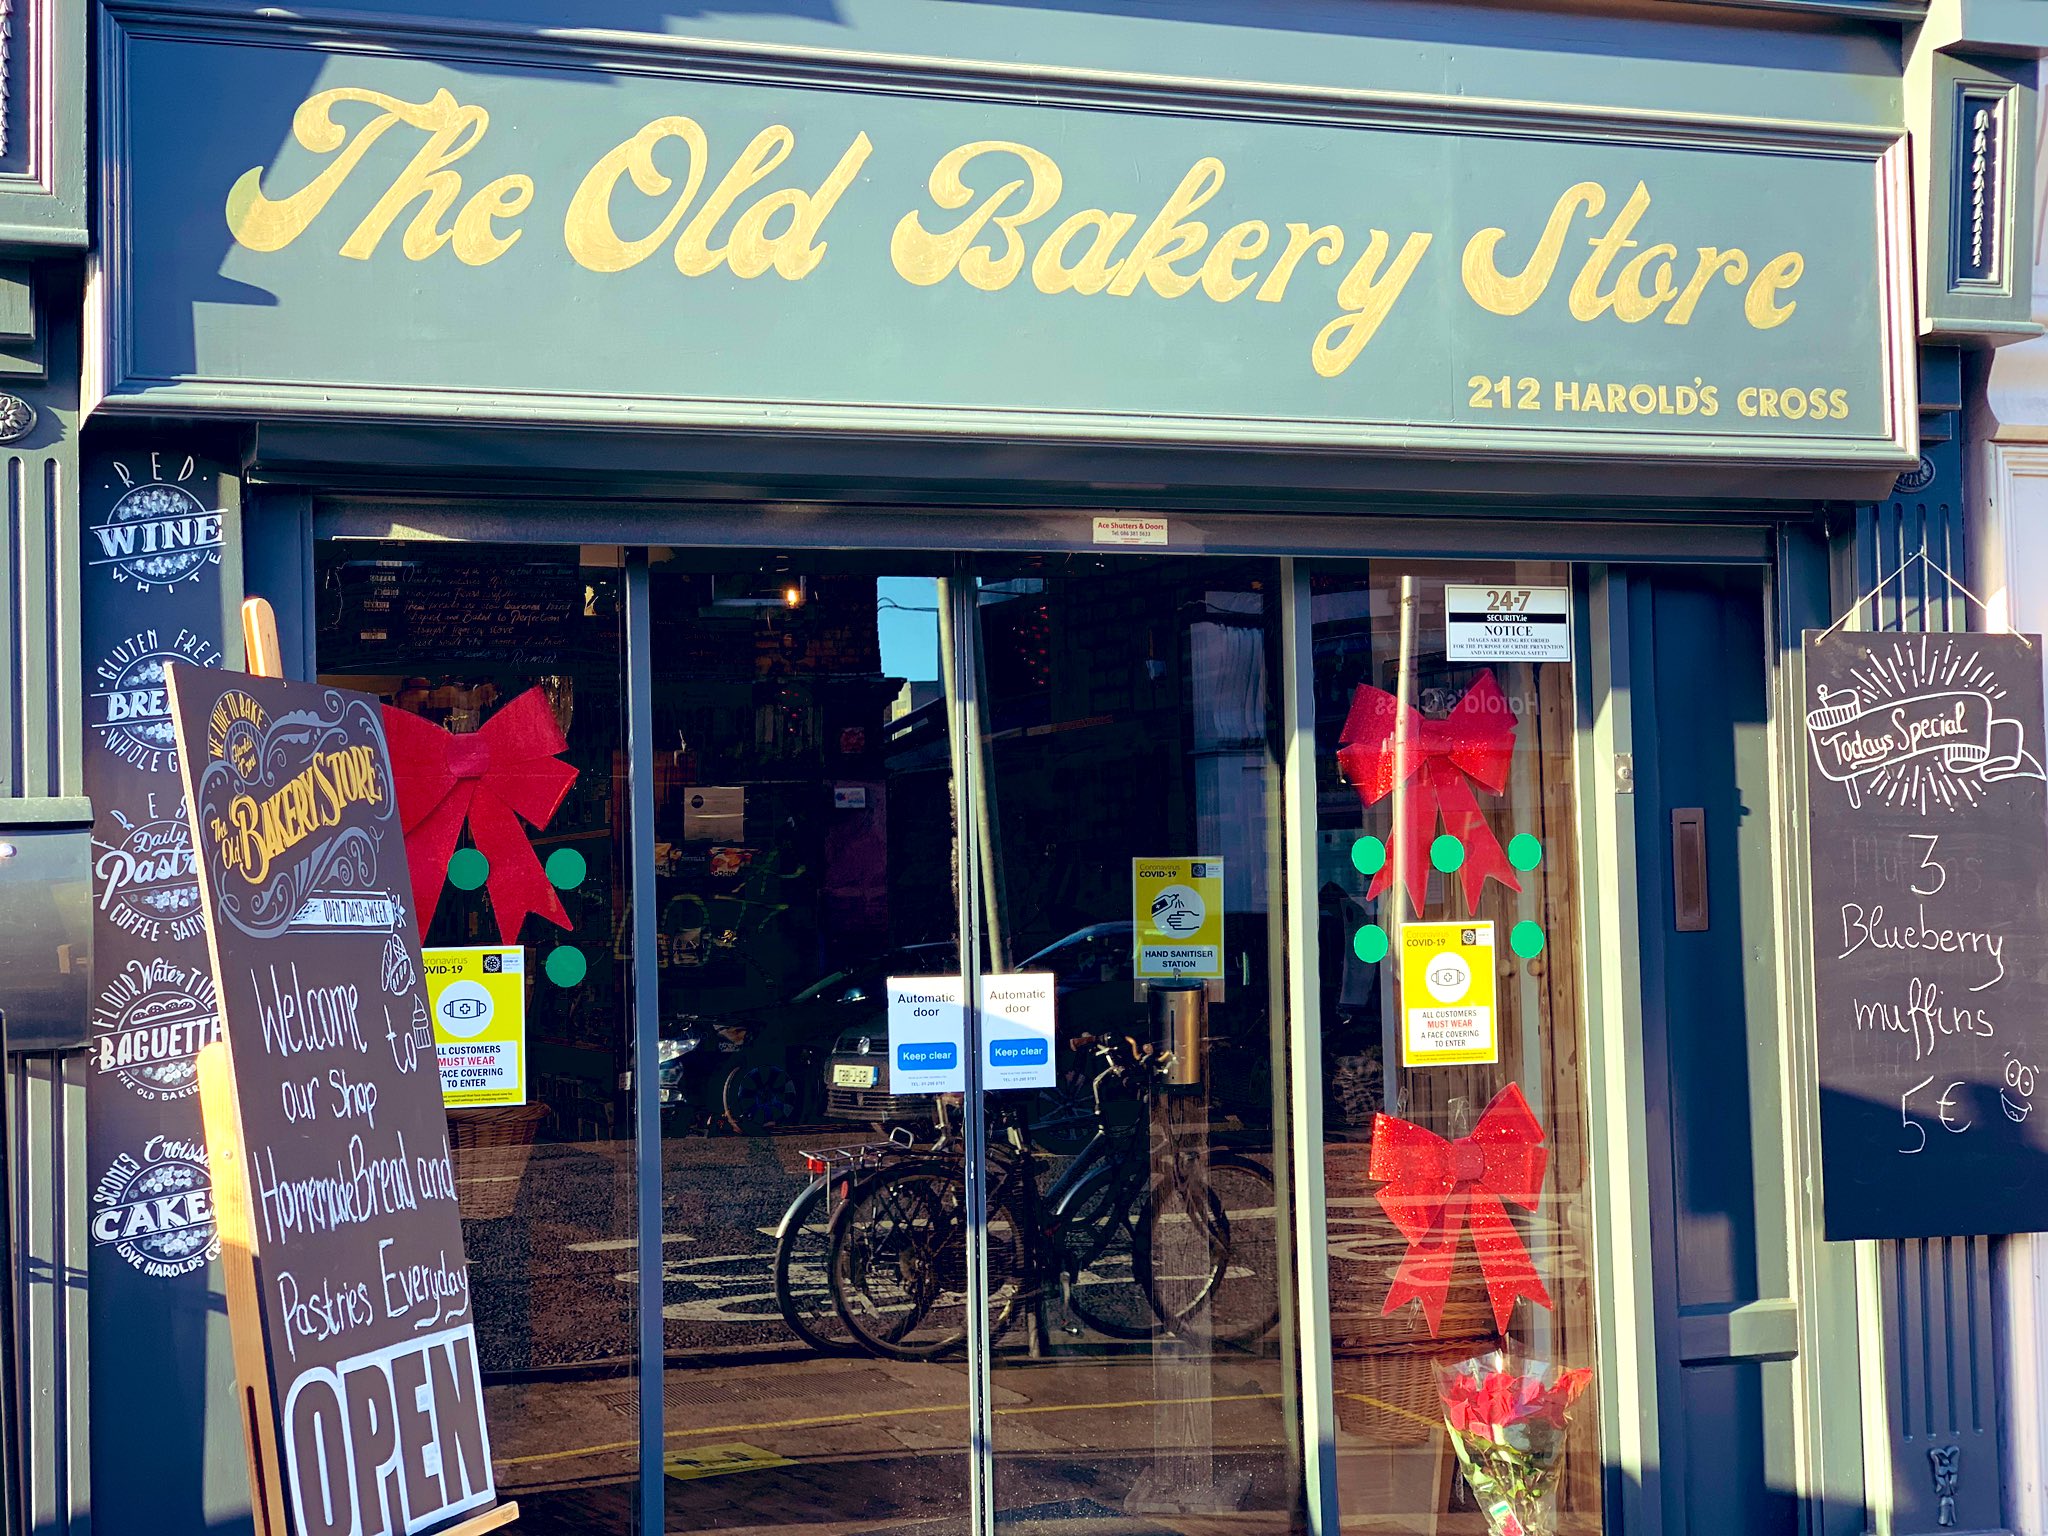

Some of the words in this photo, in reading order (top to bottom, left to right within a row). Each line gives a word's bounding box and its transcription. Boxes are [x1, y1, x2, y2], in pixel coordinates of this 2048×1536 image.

[226, 87, 534, 266] The
[565, 115, 873, 280] Old
[890, 140, 1433, 378] Bakery
[1461, 179, 1804, 330] Store
[1467, 374, 1541, 411] 212
[1554, 376, 1720, 417] HAROLD'S
[1737, 386, 1850, 421] CROSS
[113, 451, 195, 489] RED
[93, 513, 223, 558] WINE
[112, 550, 222, 594] WHITE
[1484, 625, 1533, 637] NOTICE
[97, 629, 159, 681] GLUTEN
[173, 628, 222, 669] FREE
[106, 690, 173, 722] BRE
[210, 701, 231, 740] LOVE
[224, 692, 240, 720] TO
[238, 692, 265, 731] BAKE
[104, 727, 161, 773] WHOLE
[209, 733, 224, 759] WE
[1820, 729, 1895, 770] Todays
[1890, 700, 1968, 754] Special
[210, 816, 229, 843] The
[229, 766, 326, 885] BAKERY
[312, 745, 383, 828] STORE
[132, 823, 190, 854] Daily
[221, 833, 243, 870] Old
[1139, 863, 1181, 871] Coronavirus
[1139, 870, 1177, 878] COVID-19
[1907, 834, 1947, 896] 3
[109, 902, 161, 942] COFFEE
[323, 900, 342, 923] OPEN
[341, 900, 348, 923] 7
[347, 901, 365, 923] DAYS
[367, 900, 390, 924] WEEK
[1406, 930, 1449, 938] Coronavirus
[1406, 938, 1446, 947] COVID-19
[1837, 902, 2005, 991] Blueberry
[1144, 950, 1169, 958] HAND
[1170, 950, 1213, 958] SANITISER
[1162, 960, 1196, 968] STATION
[92, 973, 142, 1029] FLOUR
[126, 957, 186, 994] Water
[897, 993, 956, 1004] Automatic
[989, 990, 1046, 1000] Automatic
[250, 961, 368, 1057] Welcome
[383, 1004, 418, 1075] to
[913, 1007, 940, 1017] door
[1005, 1004, 1031, 1013] door
[1435, 1009, 1477, 1018] CUSTOMERS
[1853, 976, 1995, 1062] muffins
[1427, 1020, 1449, 1029] MUST
[1450, 1019, 1473, 1028] WEAR
[1427, 1031, 1444, 1039] FACE
[1445, 1030, 1480, 1038] COVERING
[437, 1047, 447, 1055] LL
[448, 1045, 501, 1055] CUSTOMERS
[903, 1051, 927, 1062] Keep
[928, 1050, 952, 1060] clear
[994, 1048, 1019, 1058] Keep
[1020, 1046, 1043, 1056] clear
[1435, 1040, 1444, 1048] TO
[1445, 1039, 1466, 1047] ENTER
[438, 1057, 465, 1066] MUST
[467, 1056, 495, 1065] WEAR
[460, 1067, 503, 1077] COVERING
[116, 1070, 136, 1090] THE
[136, 1087, 155, 1101] OLD
[161, 1084, 200, 1101] BAKER
[447, 1079, 458, 1088] TO
[460, 1078, 486, 1088] ENTER
[281, 1076, 320, 1124] our
[329, 1068, 378, 1130] Shop
[93, 1152, 142, 1207] SCONES
[349, 1130, 417, 1223] Bread
[417, 1134, 458, 1202] and
[116, 1241, 145, 1270] LOVE
[276, 1270, 374, 1363] Pastries
[378, 1237, 470, 1331] Everyday
[283, 1322, 497, 1536] OPEN
